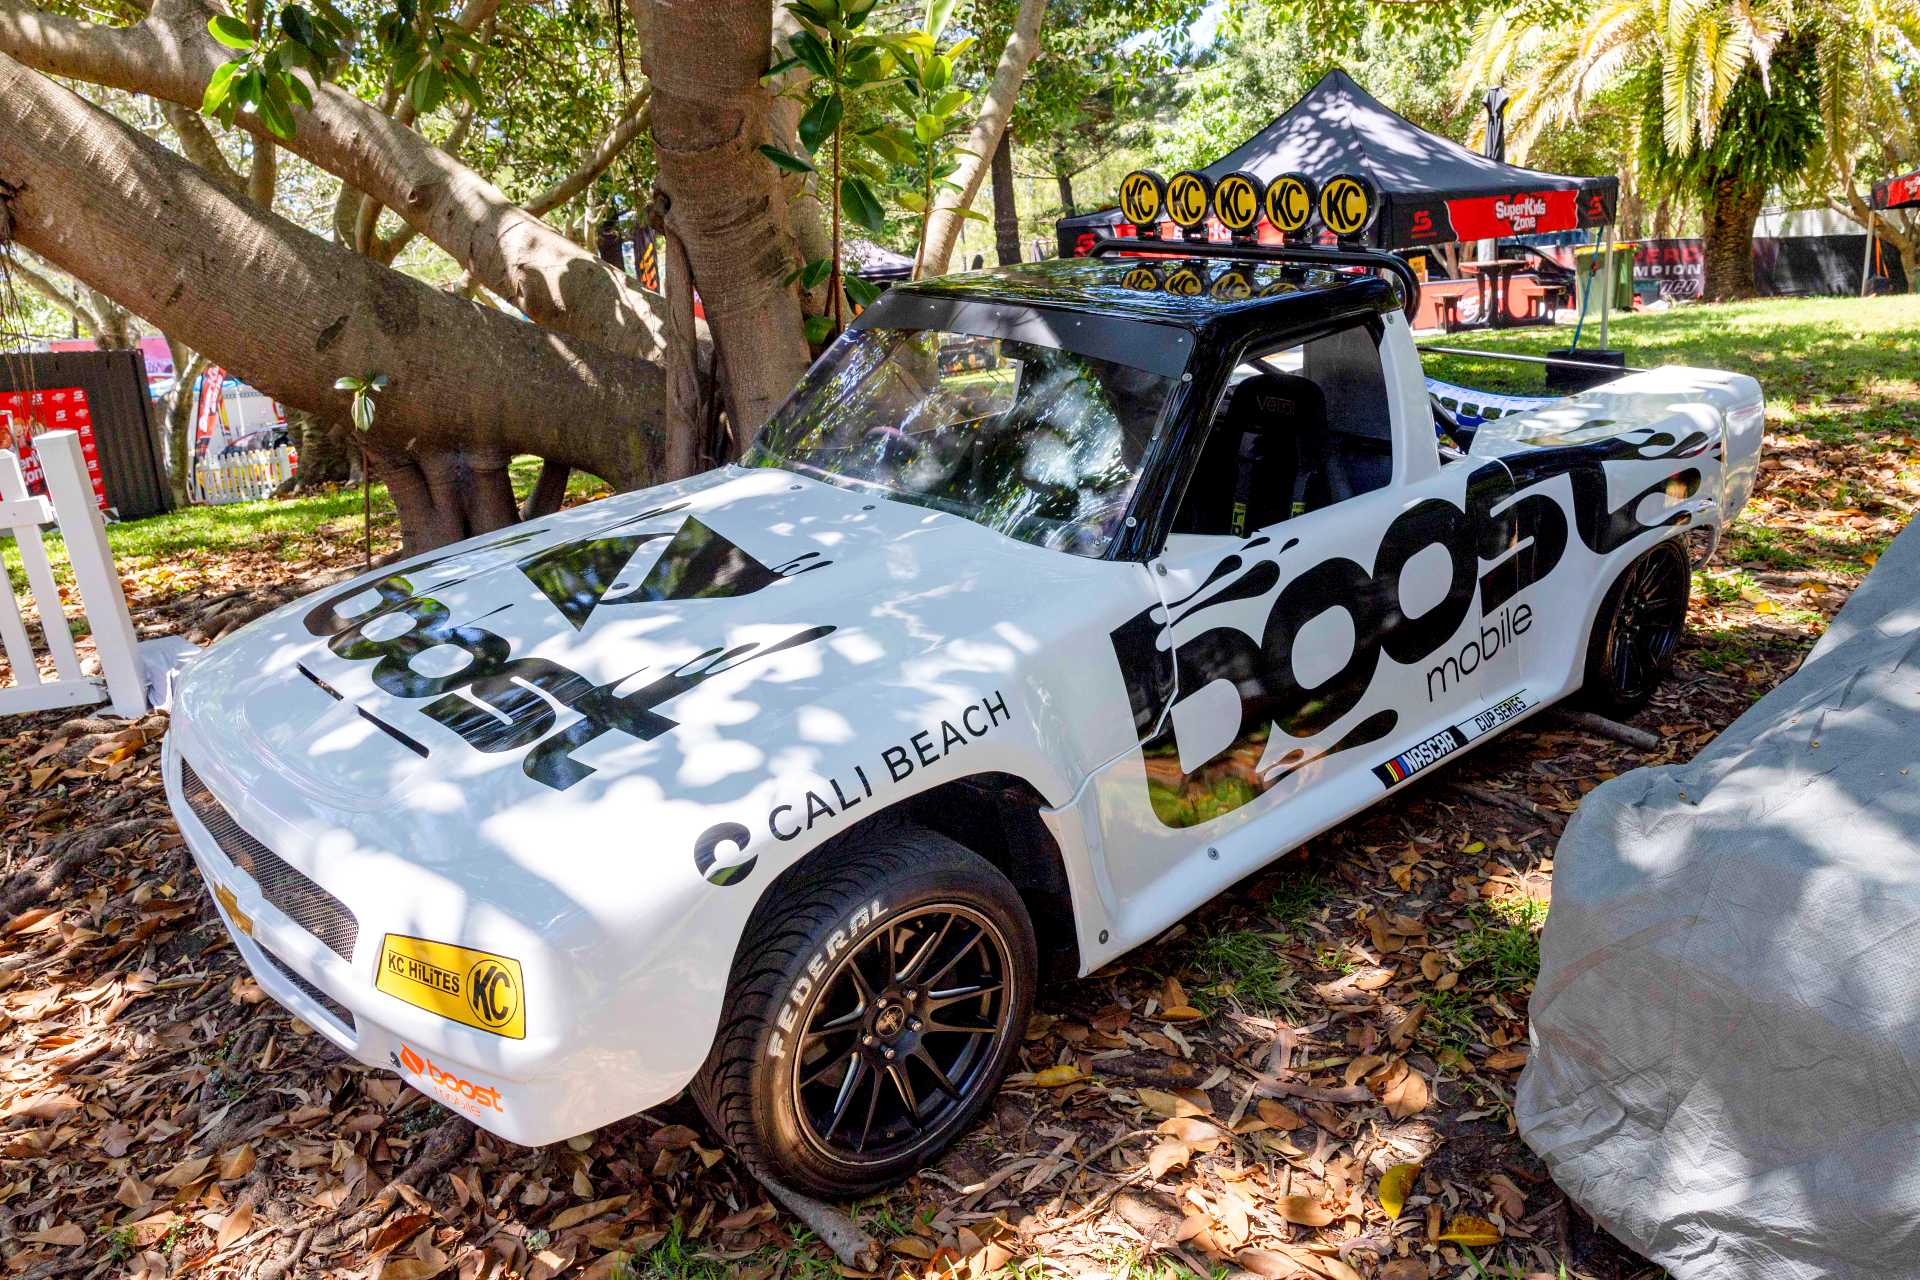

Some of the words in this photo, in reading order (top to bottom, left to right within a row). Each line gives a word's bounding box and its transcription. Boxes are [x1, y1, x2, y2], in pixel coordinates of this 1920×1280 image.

[1126, 178, 1154, 220] KC
[1171, 178, 1202, 222] KC
[1220, 180, 1252, 225] KC
[1271, 182, 1305, 227] KC
[1326, 183, 1362, 229] KC
[1495, 197, 1546, 219] SuperKids
[1513, 215, 1536, 231] Zone
[1110, 445, 1705, 828] boost
[1426, 604, 1533, 702] mobile
[1401, 730, 1459, 773] NASCAR
[1474, 712, 1496, 732] CUP
[1494, 696, 1528, 722] SERIES
[768, 766, 873, 841] CALI
[881, 690, 1011, 783] BEACH
[388, 953, 405, 974] KC
[767, 899, 889, 1059] FEDERAL
[472, 965, 511, 1022] KC
[426, 1056, 504, 1112] boost
